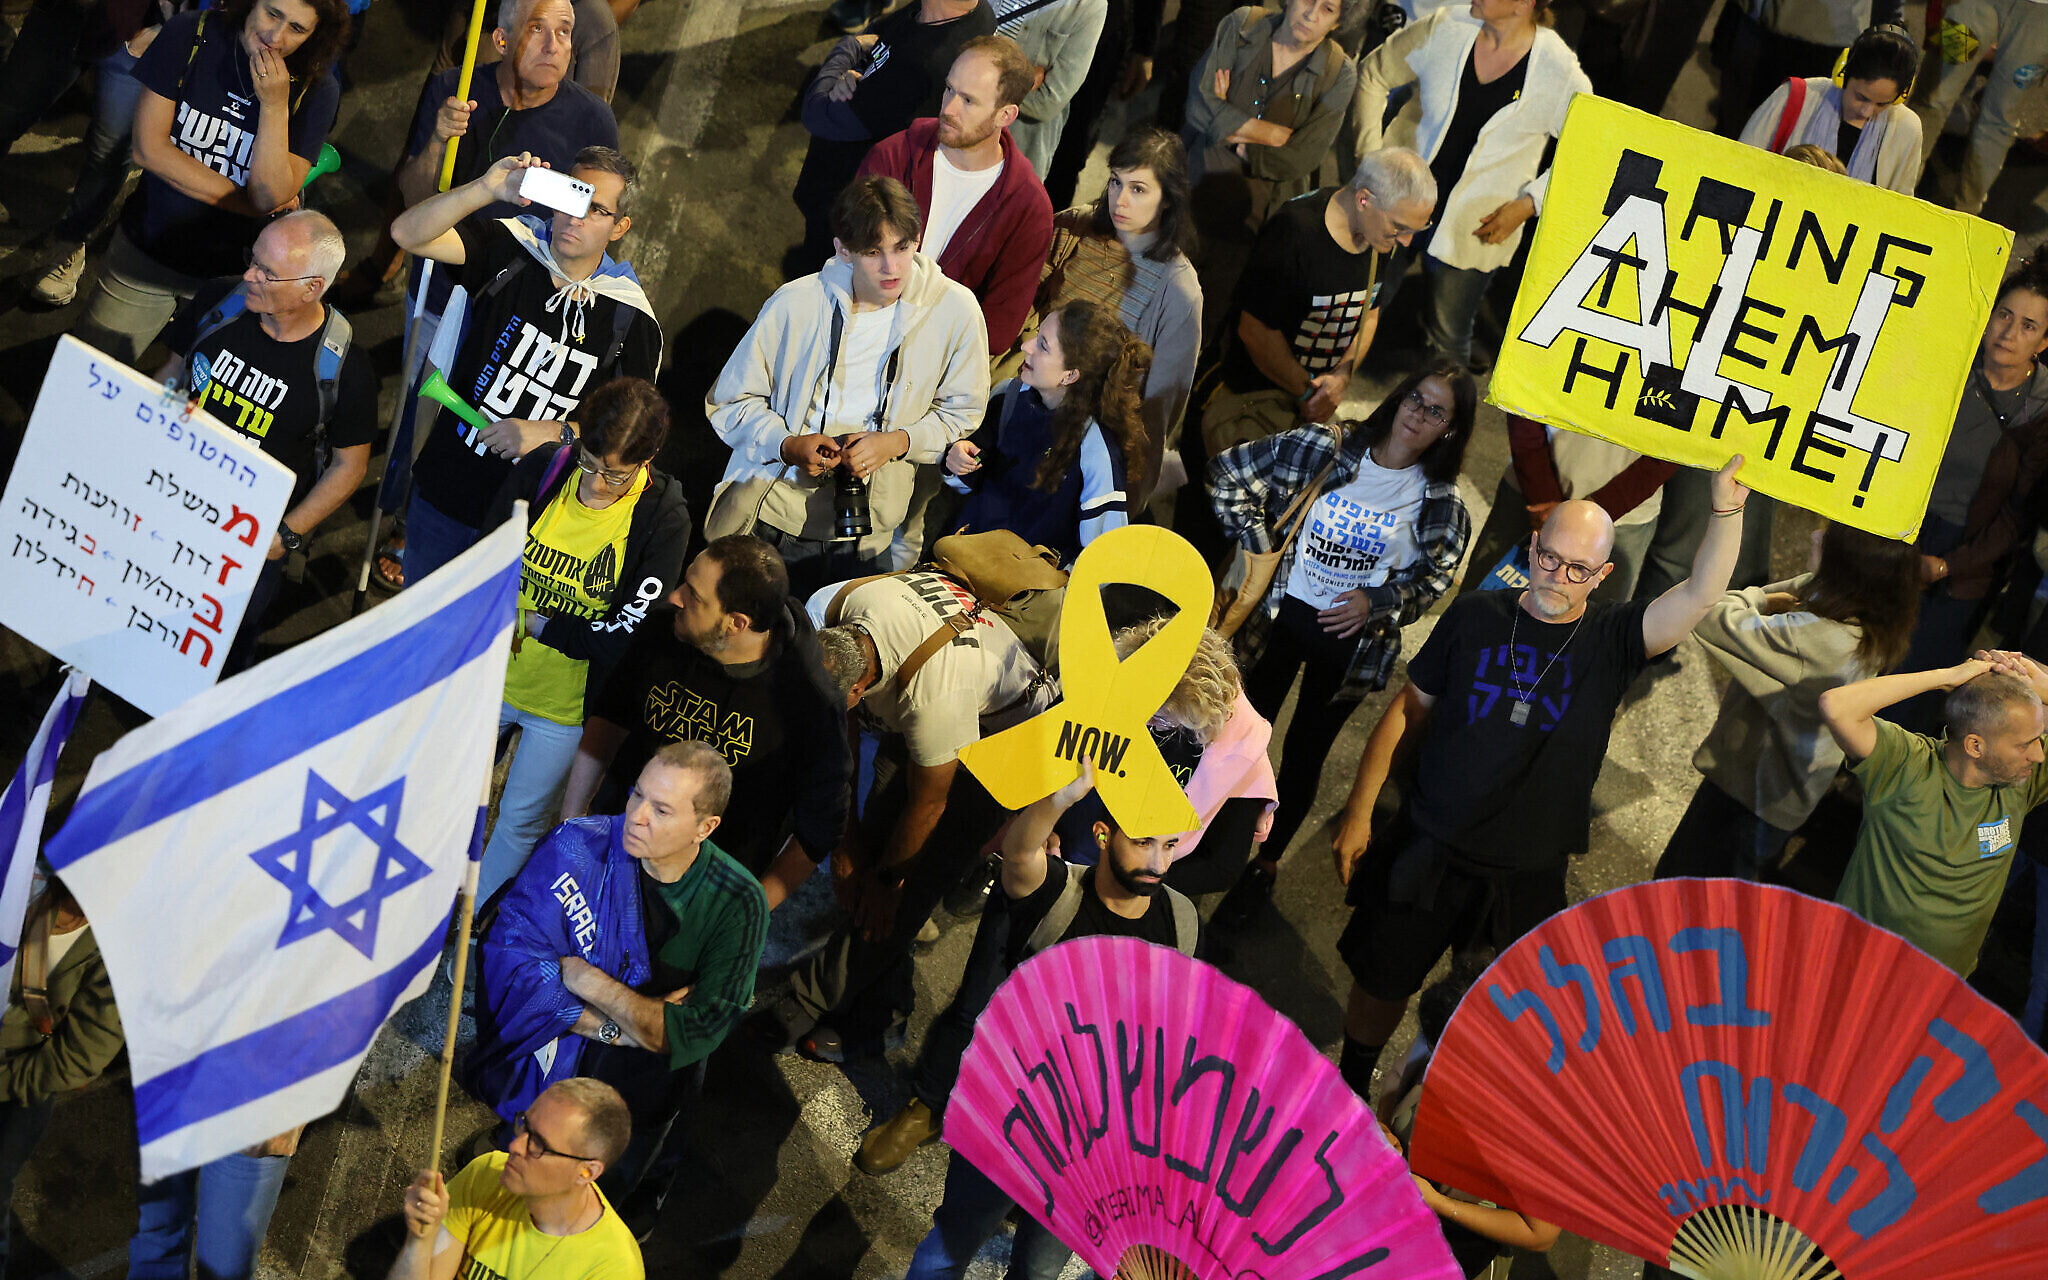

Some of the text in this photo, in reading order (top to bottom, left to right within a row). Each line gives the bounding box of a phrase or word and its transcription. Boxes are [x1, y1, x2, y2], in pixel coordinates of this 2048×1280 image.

[177, 101, 254, 167] ופשי
[1518, 195, 1909, 462] ALL
[1591, 244, 1861, 391] THEM
[210, 349, 289, 411] למה הם
[88, 363, 258, 488] החטופים על
[21, 498, 97, 556] בגידה
[1312, 519, 1386, 554] השלום
[13, 534, 95, 596] חידלון
[1054, 720, 1132, 779] NOW.
